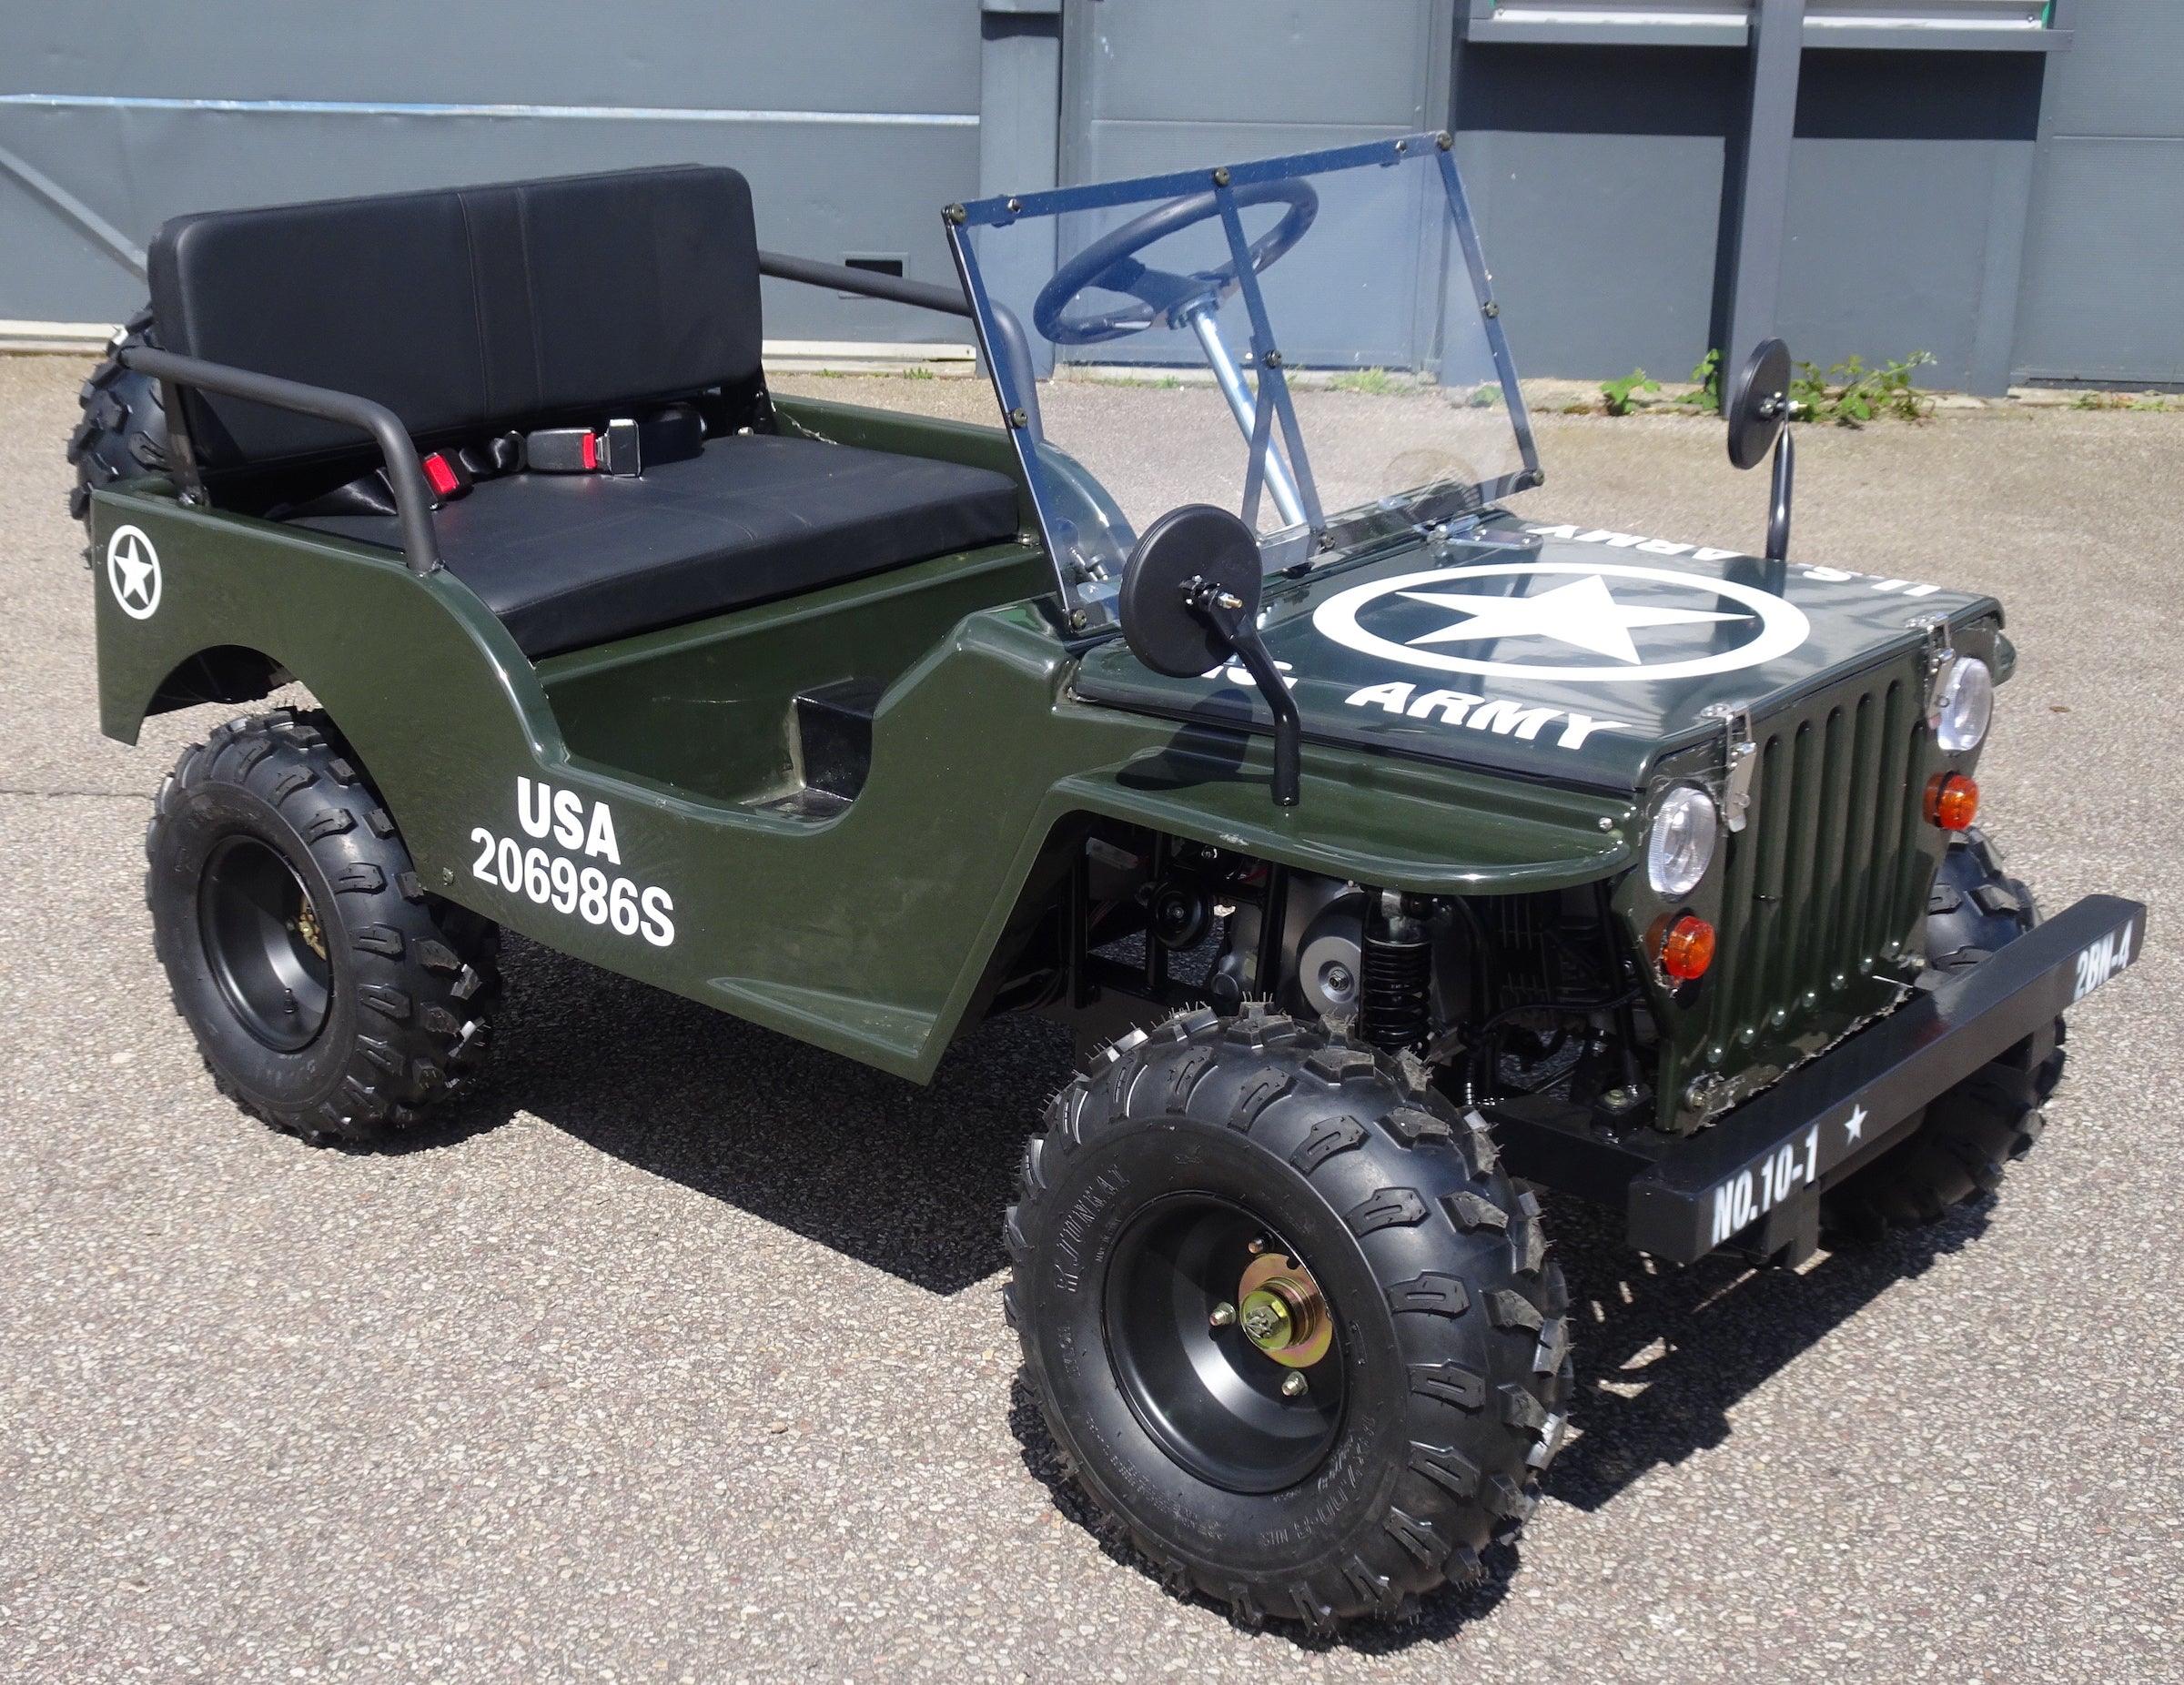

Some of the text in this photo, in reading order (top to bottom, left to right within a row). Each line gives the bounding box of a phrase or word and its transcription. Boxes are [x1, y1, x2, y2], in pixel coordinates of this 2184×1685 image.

[1344, 681, 1633, 750] ARMY
[517, 775, 622, 866] USA
[470, 827, 675, 947] 206986S
[1712, 1124, 1819, 1247] NO.10-1
